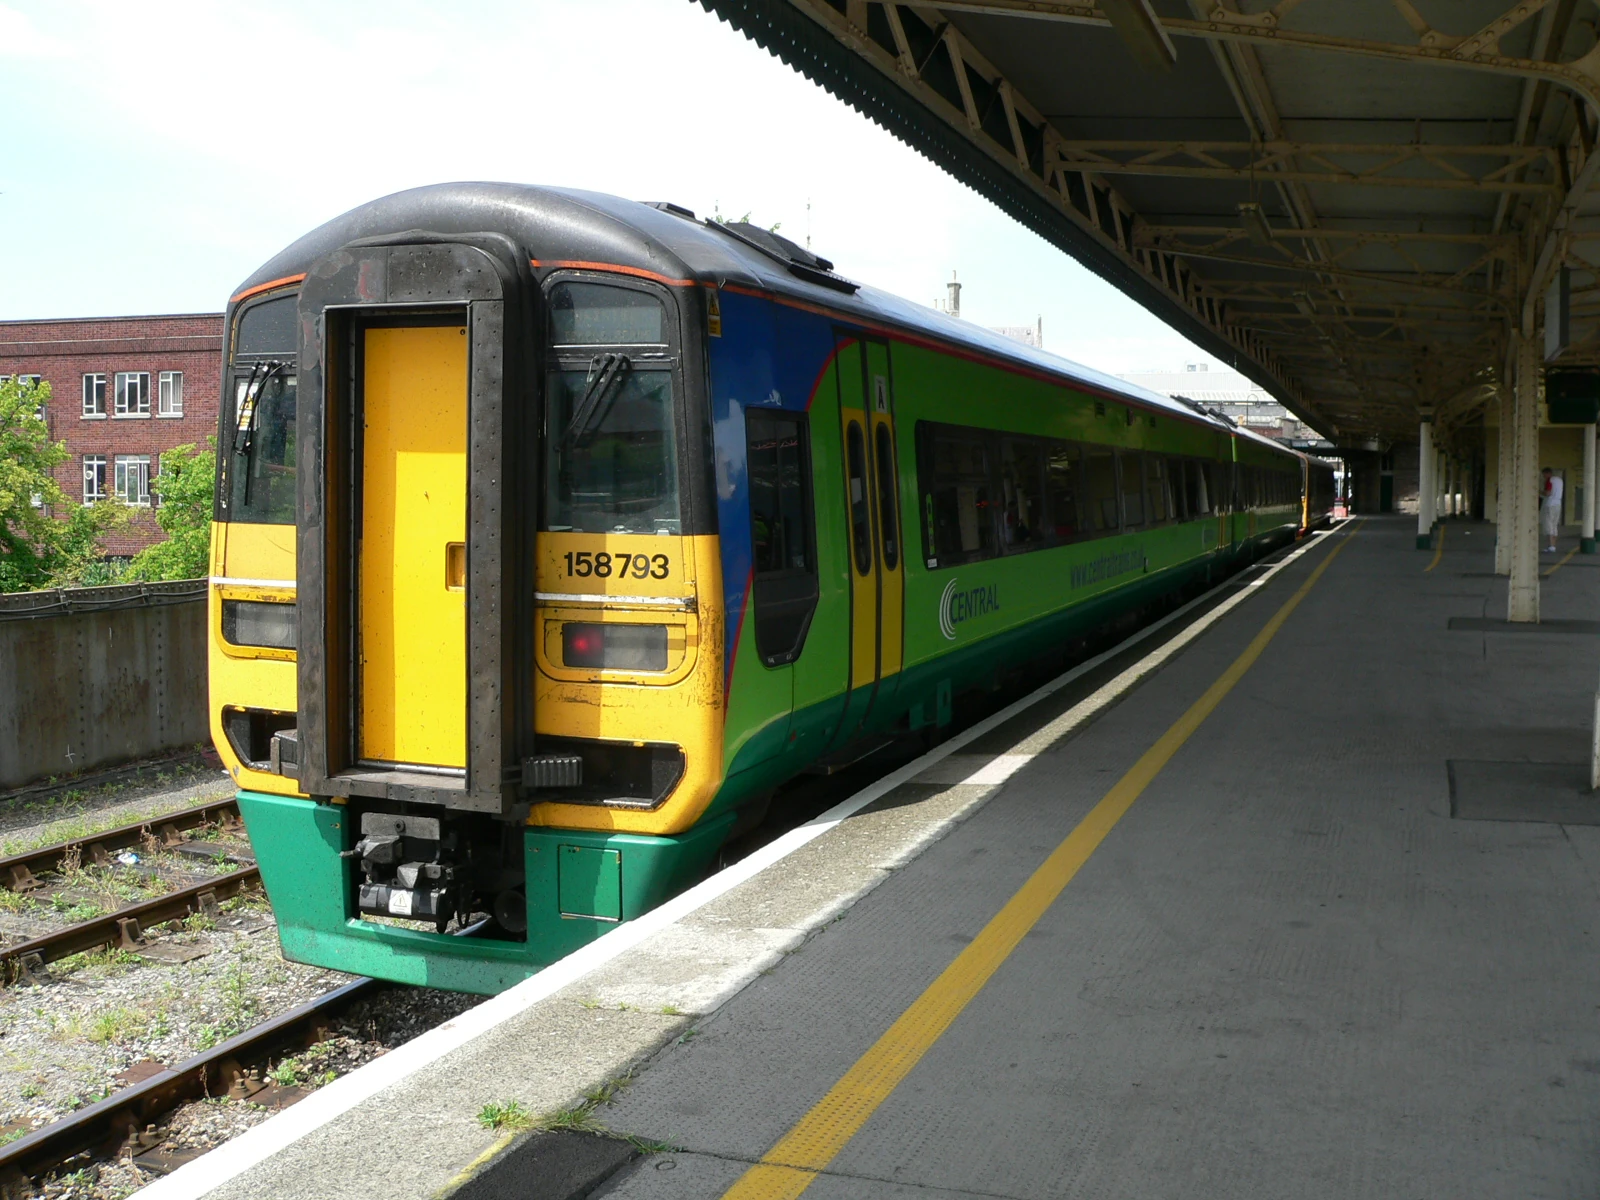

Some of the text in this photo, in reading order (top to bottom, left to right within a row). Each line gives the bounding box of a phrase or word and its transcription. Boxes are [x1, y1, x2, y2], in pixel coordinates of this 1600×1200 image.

[878, 384, 885, 410] A
[564, 551, 669, 580] 158793
[951, 583, 1000, 624] CENTRAL
